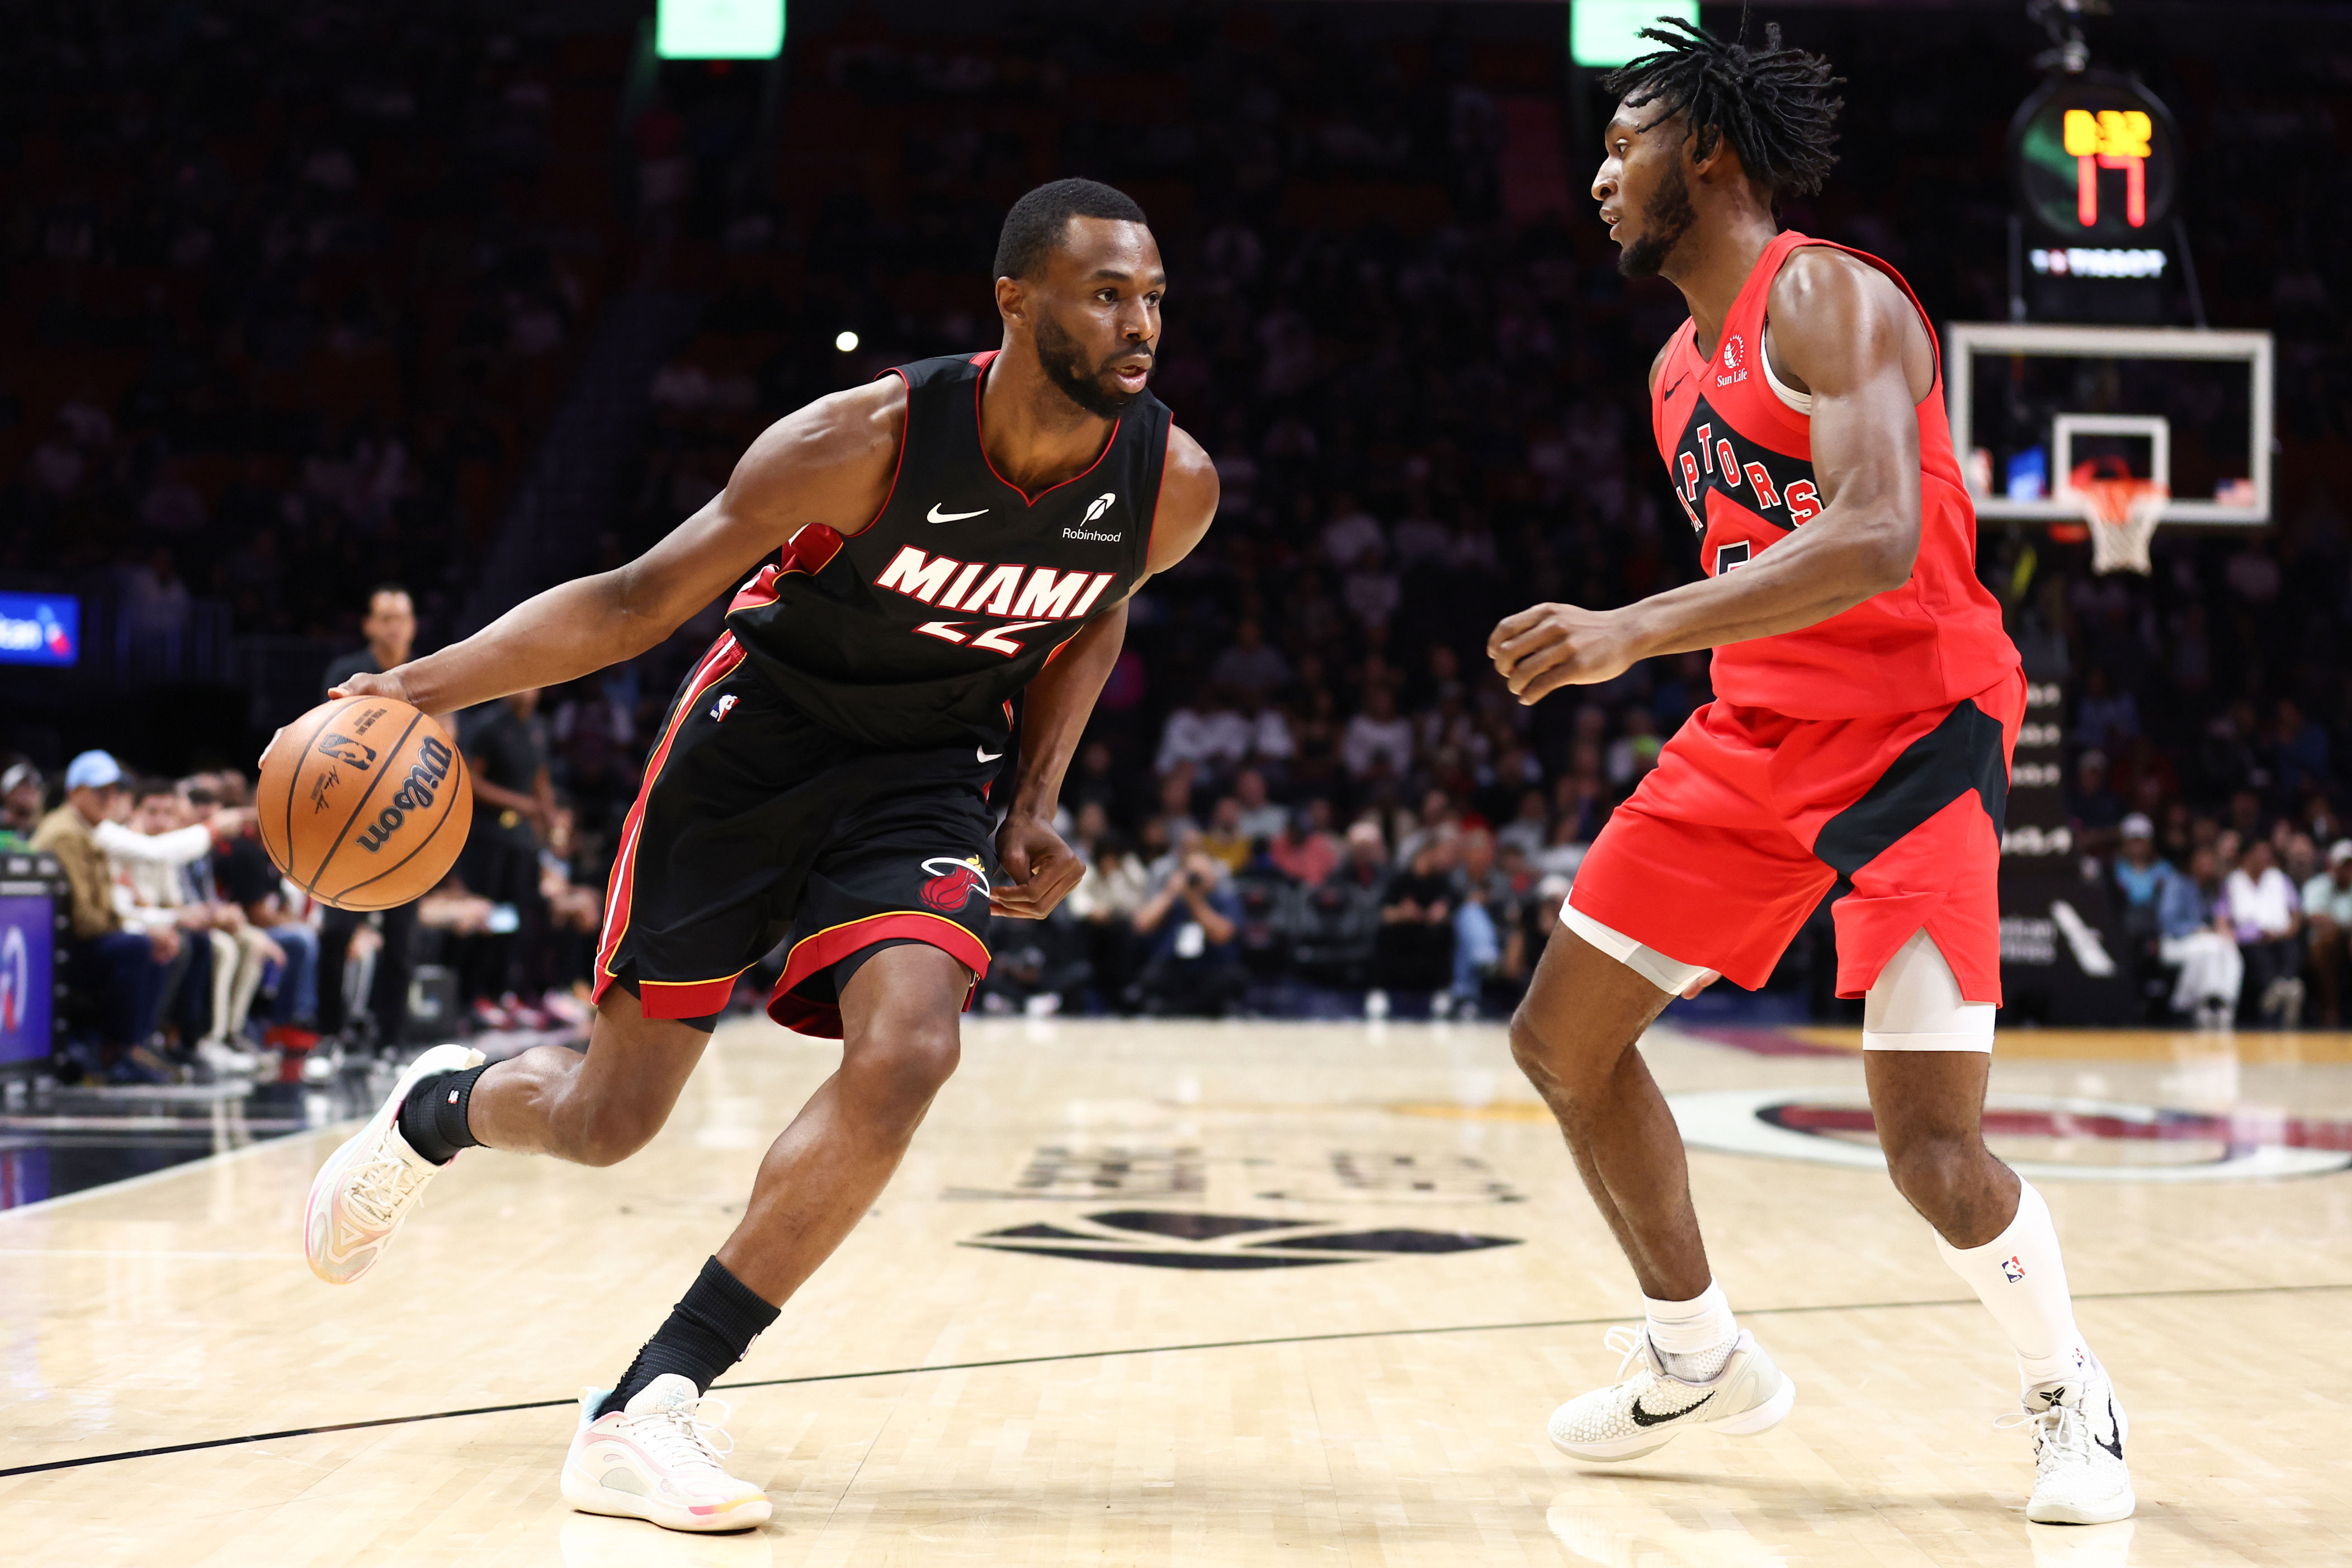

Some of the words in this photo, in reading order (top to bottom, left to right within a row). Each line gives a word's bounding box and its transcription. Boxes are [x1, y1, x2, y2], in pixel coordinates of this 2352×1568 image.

[1717, 375, 1732, 388] Sun
[1734, 367, 1748, 383] Life
[1676, 422, 1824, 533] APTORS
[1062, 527, 1122, 542] Robinhood
[872, 544, 1117, 620] MIAMI
[710, 710, 719, 719] NBA
[355, 735, 452, 853] Wilson
